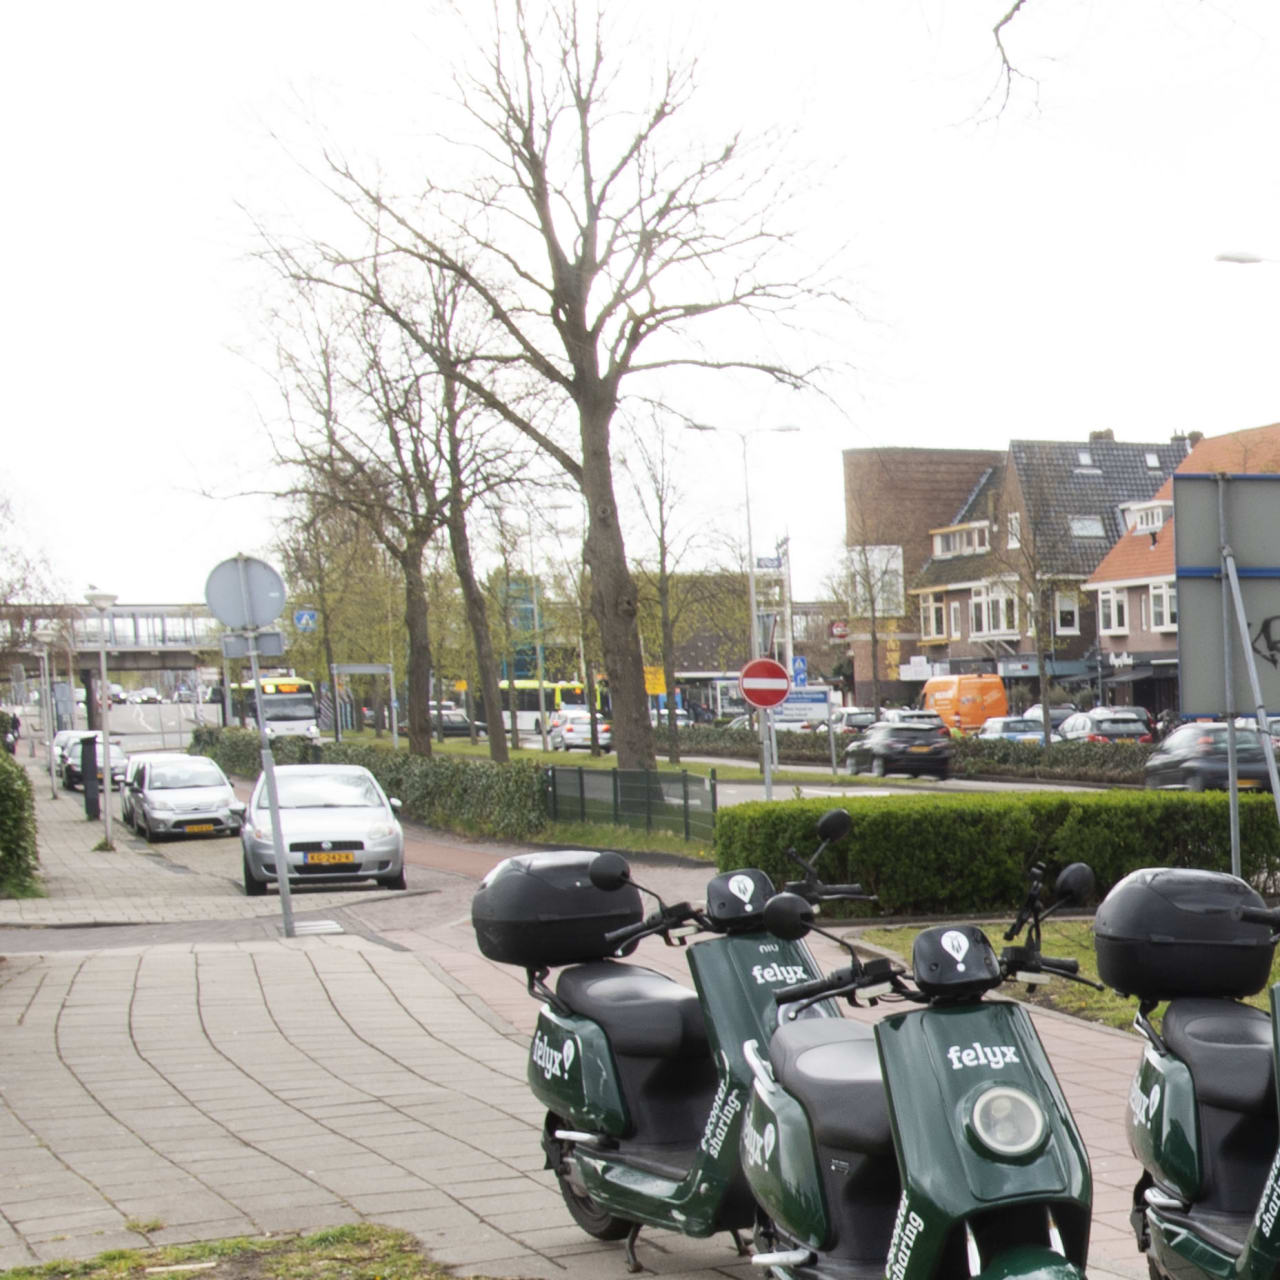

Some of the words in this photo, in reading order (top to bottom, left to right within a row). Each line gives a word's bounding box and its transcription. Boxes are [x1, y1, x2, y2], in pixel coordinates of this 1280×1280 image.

[751, 962, 808, 985] felyx
[946, 1042, 1020, 1070] felyx
[709, 1090, 741, 1159] sharing
